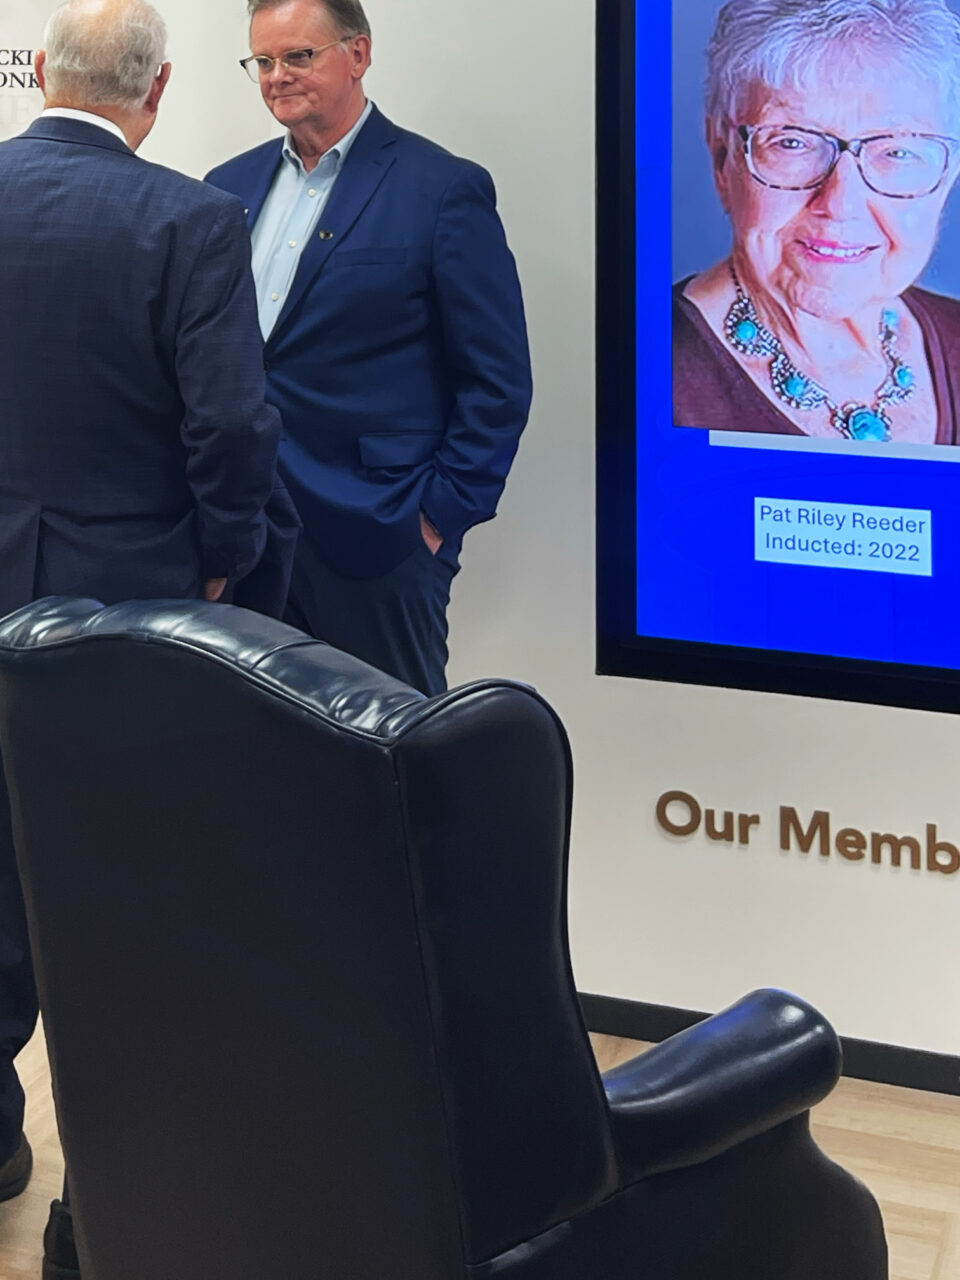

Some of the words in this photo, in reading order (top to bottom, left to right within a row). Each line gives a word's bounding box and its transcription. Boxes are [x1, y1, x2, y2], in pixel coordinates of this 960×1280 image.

[760, 505, 792, 523] Pat
[797, 507, 846, 531] Riley
[852, 512, 926, 534] Reeder
[765, 532, 862, 557] Inducted:
[868, 541, 920, 562] 2022
[656, 790, 759, 845] Our
[779, 805, 960, 875] Memb
